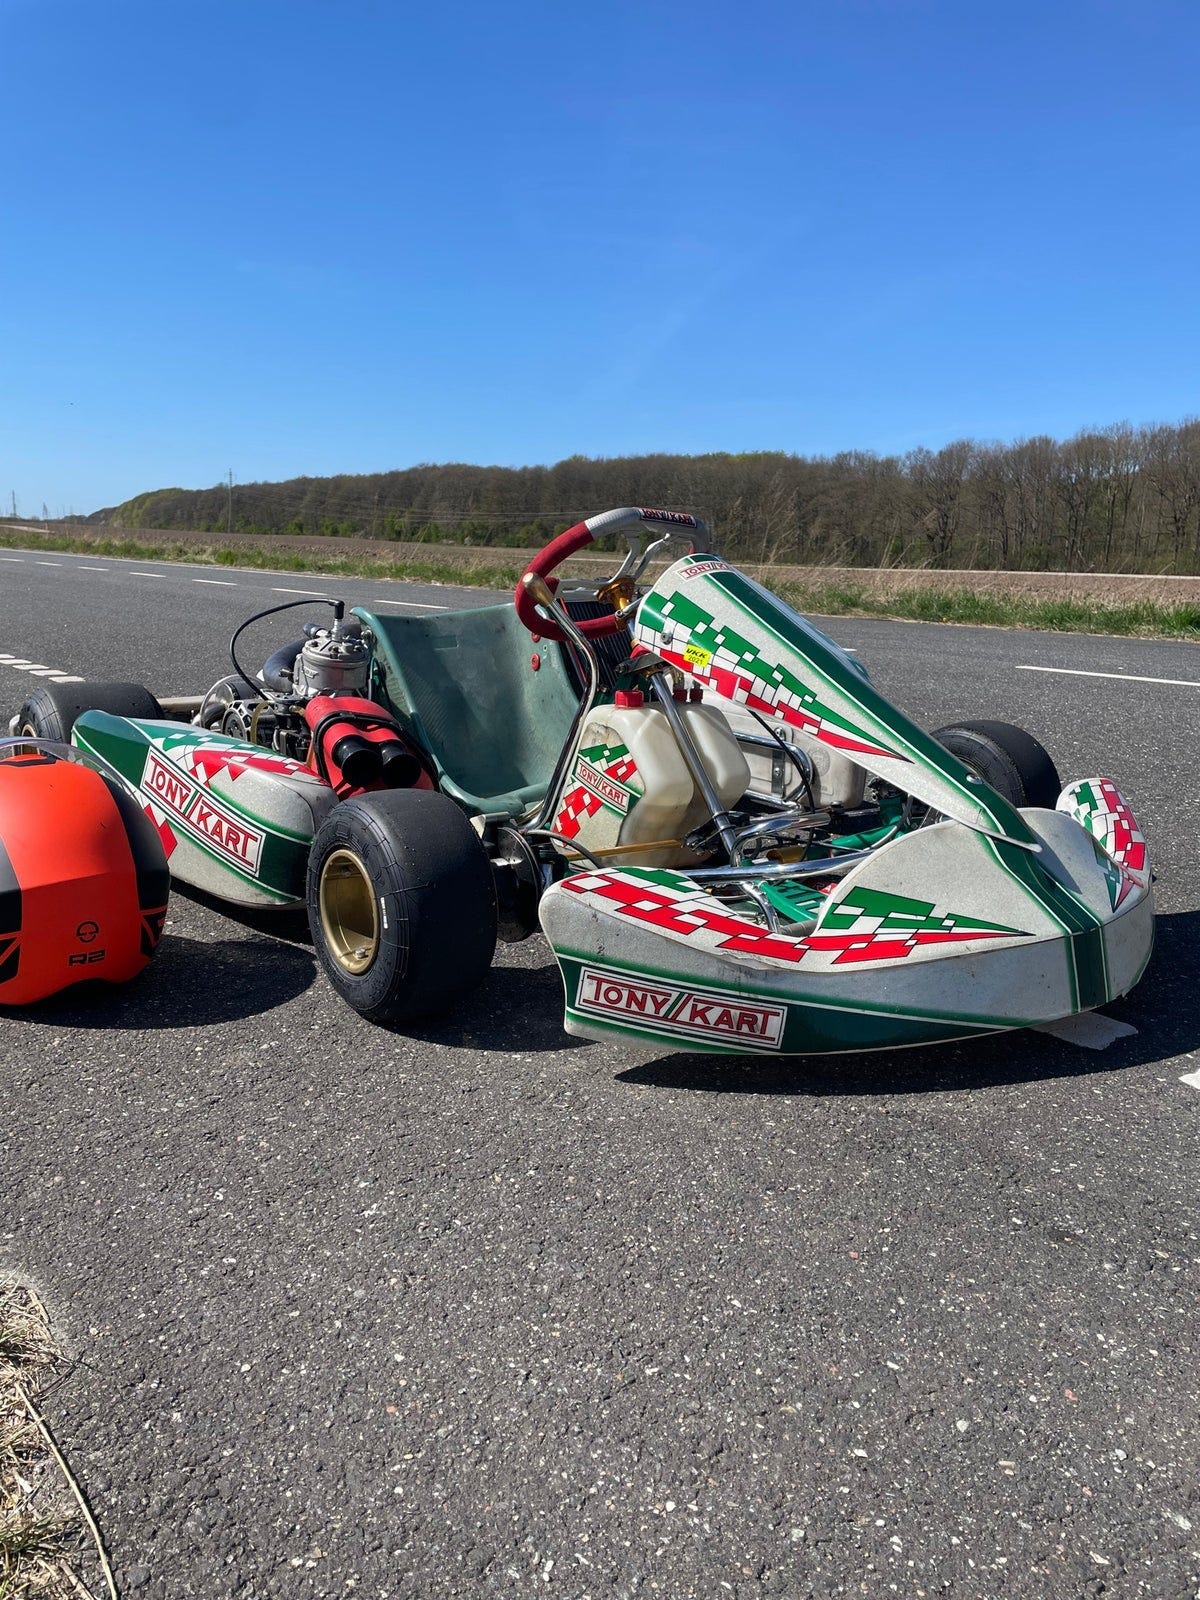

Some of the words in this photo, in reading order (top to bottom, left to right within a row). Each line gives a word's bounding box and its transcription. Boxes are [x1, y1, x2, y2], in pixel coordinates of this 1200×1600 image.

[681, 562, 711, 576] TONY
[579, 762, 598, 788] TONY
[601, 782, 627, 804] KART
[150, 755, 191, 809] TONY
[197, 799, 258, 858] KART
[68, 949, 105, 966] R2
[587, 975, 672, 1014] TONY
[689, 998, 780, 1035] KART
